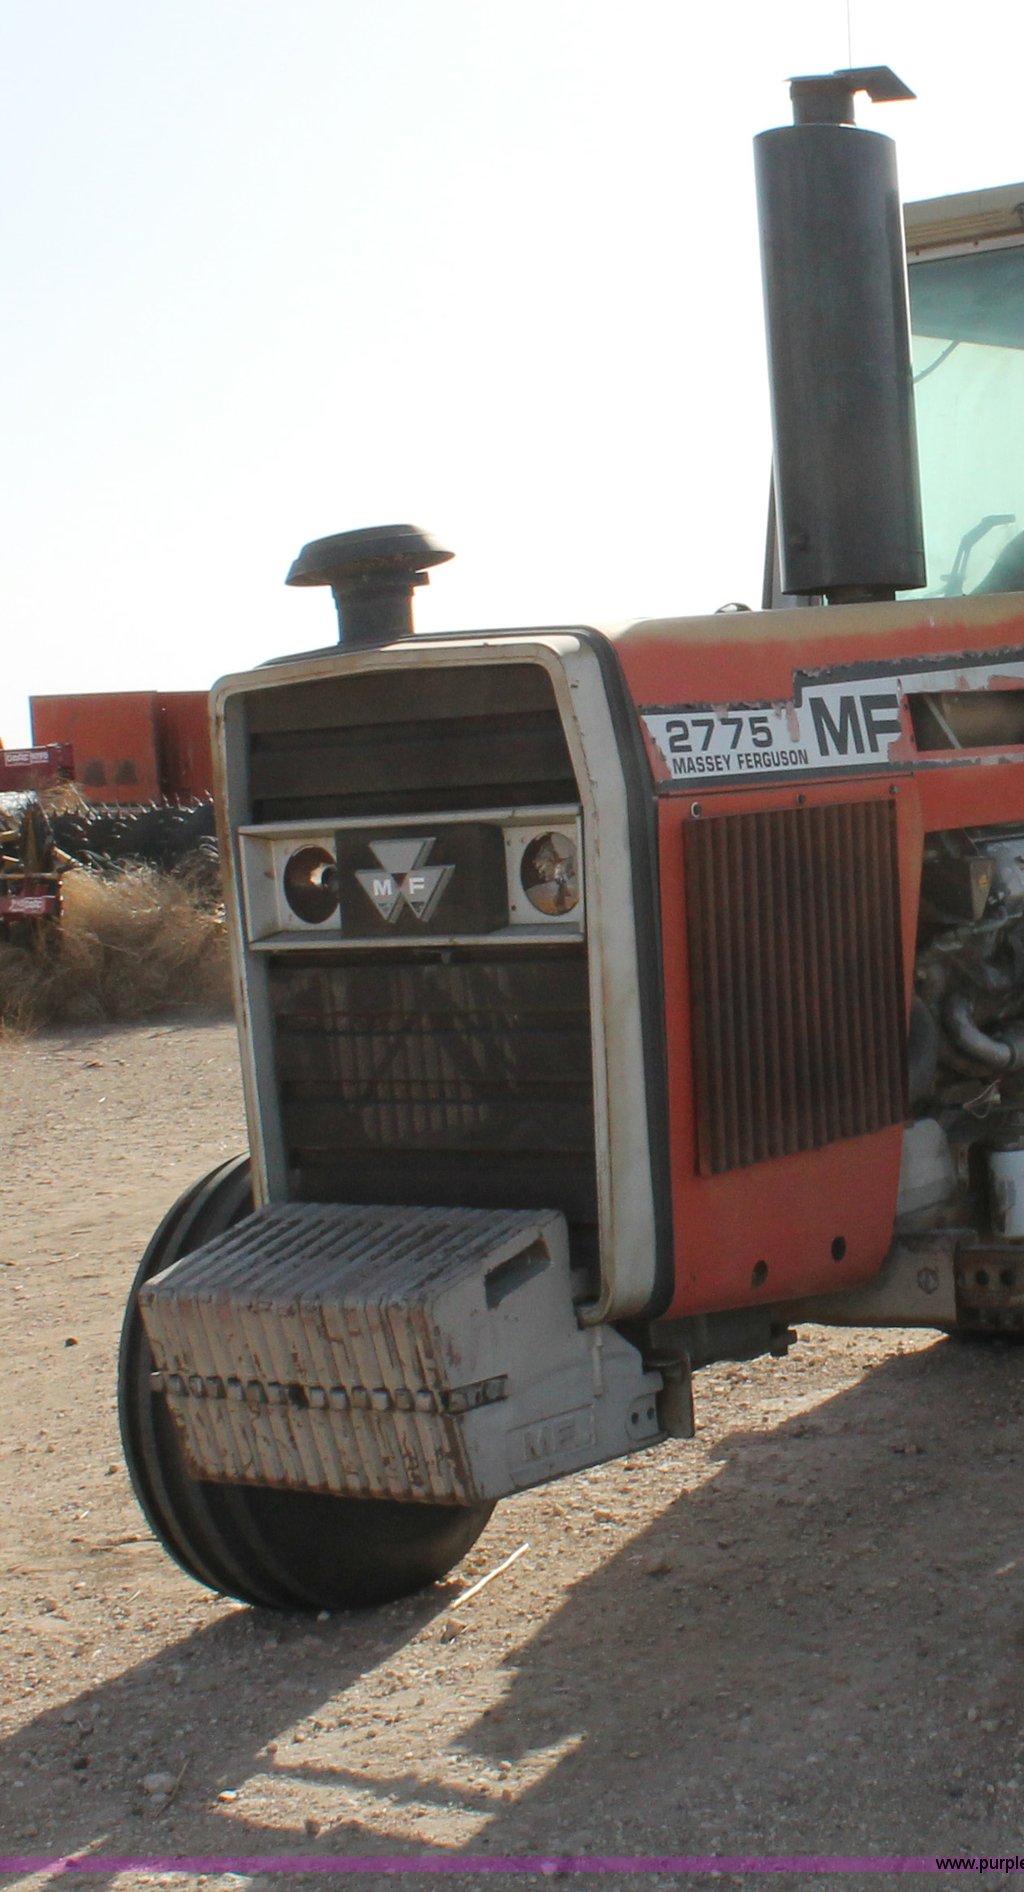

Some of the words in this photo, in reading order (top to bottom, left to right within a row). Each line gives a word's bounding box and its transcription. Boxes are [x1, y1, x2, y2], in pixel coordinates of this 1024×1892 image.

[665, 716, 774, 754] 2775
[808, 693, 902, 757] MF
[672, 754, 731, 775] MASSEY
[737, 749, 809, 770] FERGUSON
